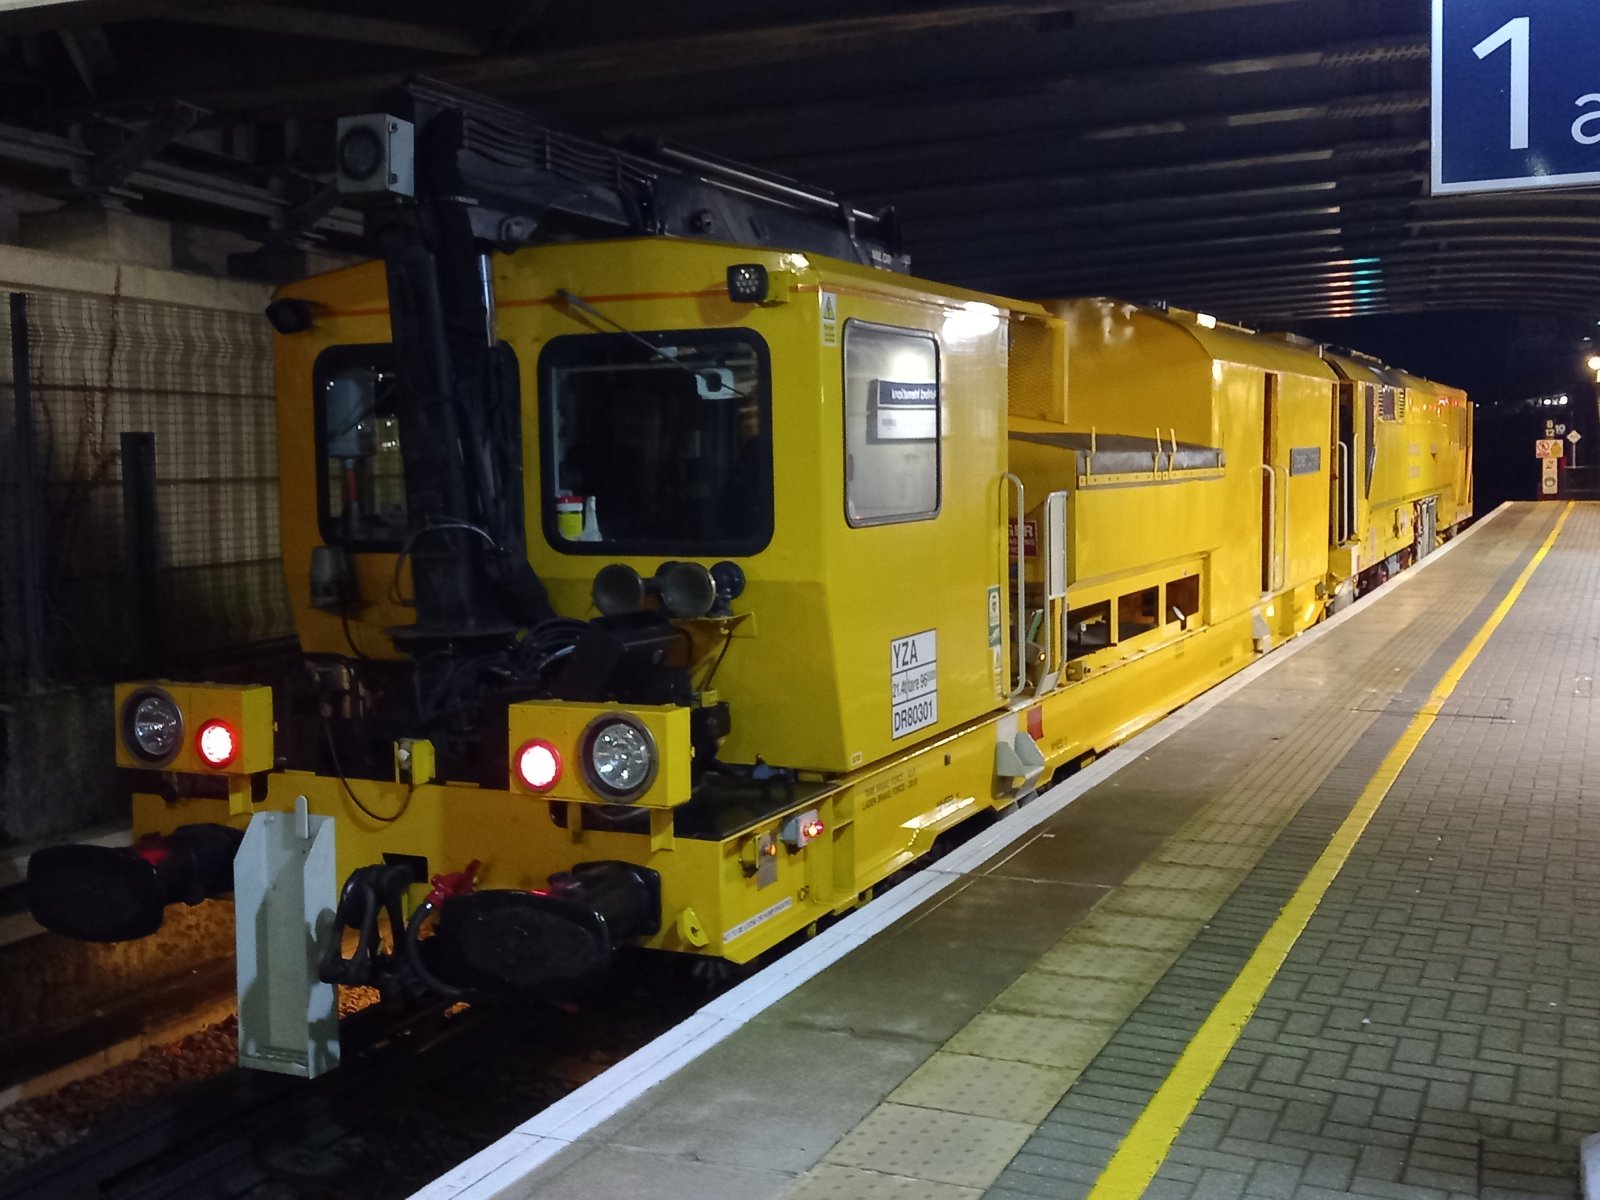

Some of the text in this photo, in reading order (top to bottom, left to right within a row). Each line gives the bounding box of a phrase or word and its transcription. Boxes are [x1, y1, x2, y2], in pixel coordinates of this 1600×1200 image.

[1472, 17, 1529, 149] 1
[893, 640, 918, 668] YZA
[894, 700, 933, 731] DR80301
